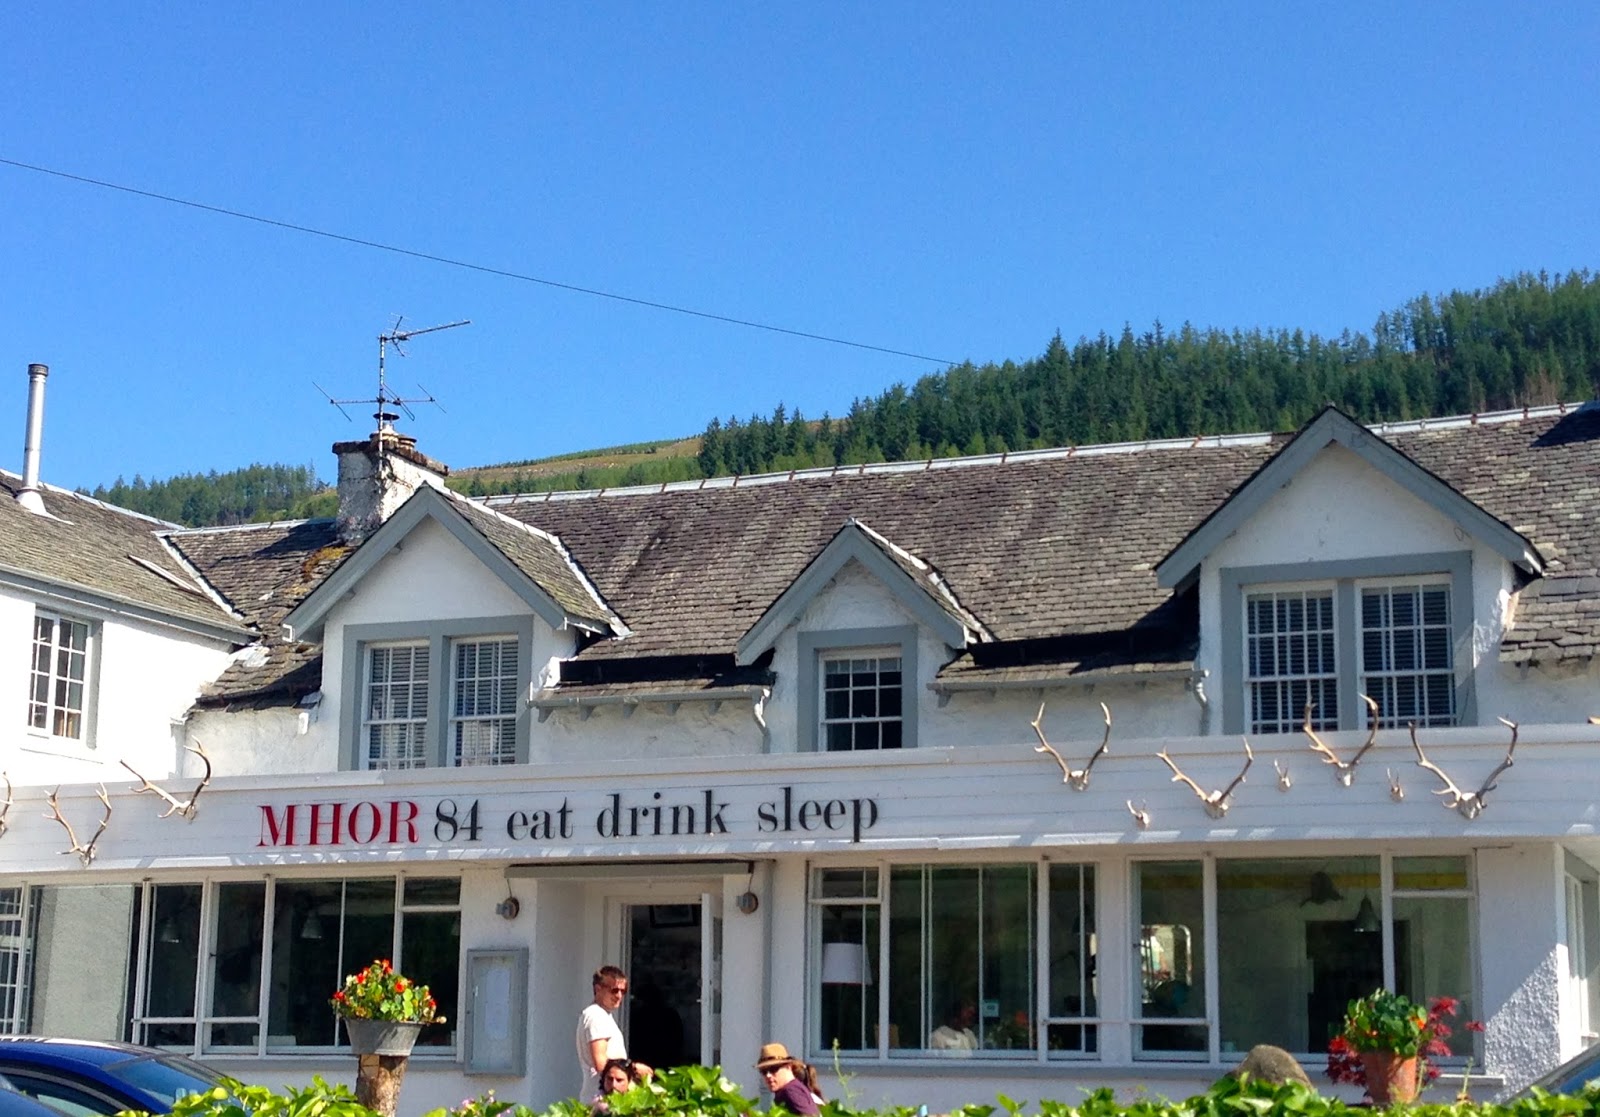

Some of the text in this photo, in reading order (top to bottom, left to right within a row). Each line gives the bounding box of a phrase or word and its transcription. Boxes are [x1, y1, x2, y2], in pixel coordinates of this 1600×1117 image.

[256, 785, 879, 847] MHOR 84 eat drink sleep
